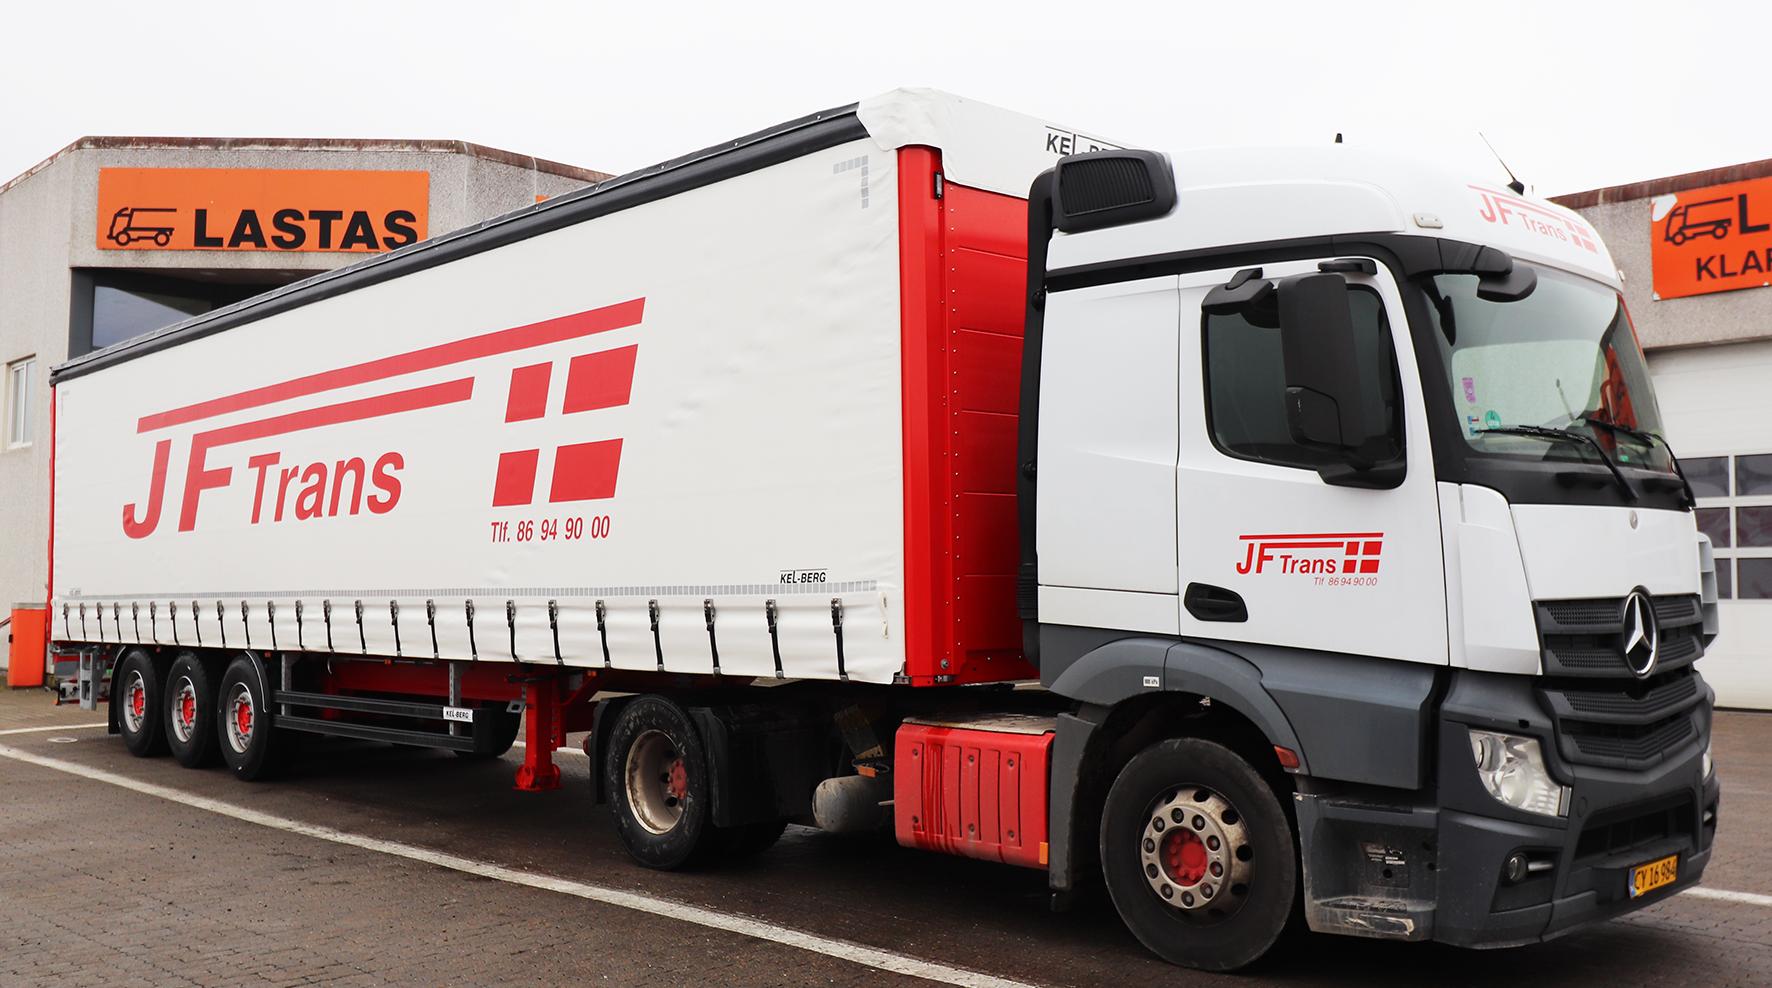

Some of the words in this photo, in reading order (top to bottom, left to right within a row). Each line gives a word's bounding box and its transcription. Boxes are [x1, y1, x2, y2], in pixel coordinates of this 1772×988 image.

[194, 209, 418, 249] LASTAS
[1517, 212, 1567, 241] Trans
[248, 451, 405, 524] Trans
[491, 521, 510, 542] Tlf.
[517, 520, 534, 542] 86
[541, 519, 557, 541] 94
[565, 517, 583, 539] 90
[591, 515, 610, 539] 00
[780, 569, 827, 584] KEL-BERG
[1279, 554, 1337, 574] Trans
[1328, 577, 1340, 586] 86
[1340, 577, 1351, 586] 94
[1353, 577, 1365, 586] 90
[1365, 577, 1378, 586] 00
[1635, 869, 1647, 890] CY
[1649, 866, 1660, 886] 16
[1661, 859, 1676, 882] 984
